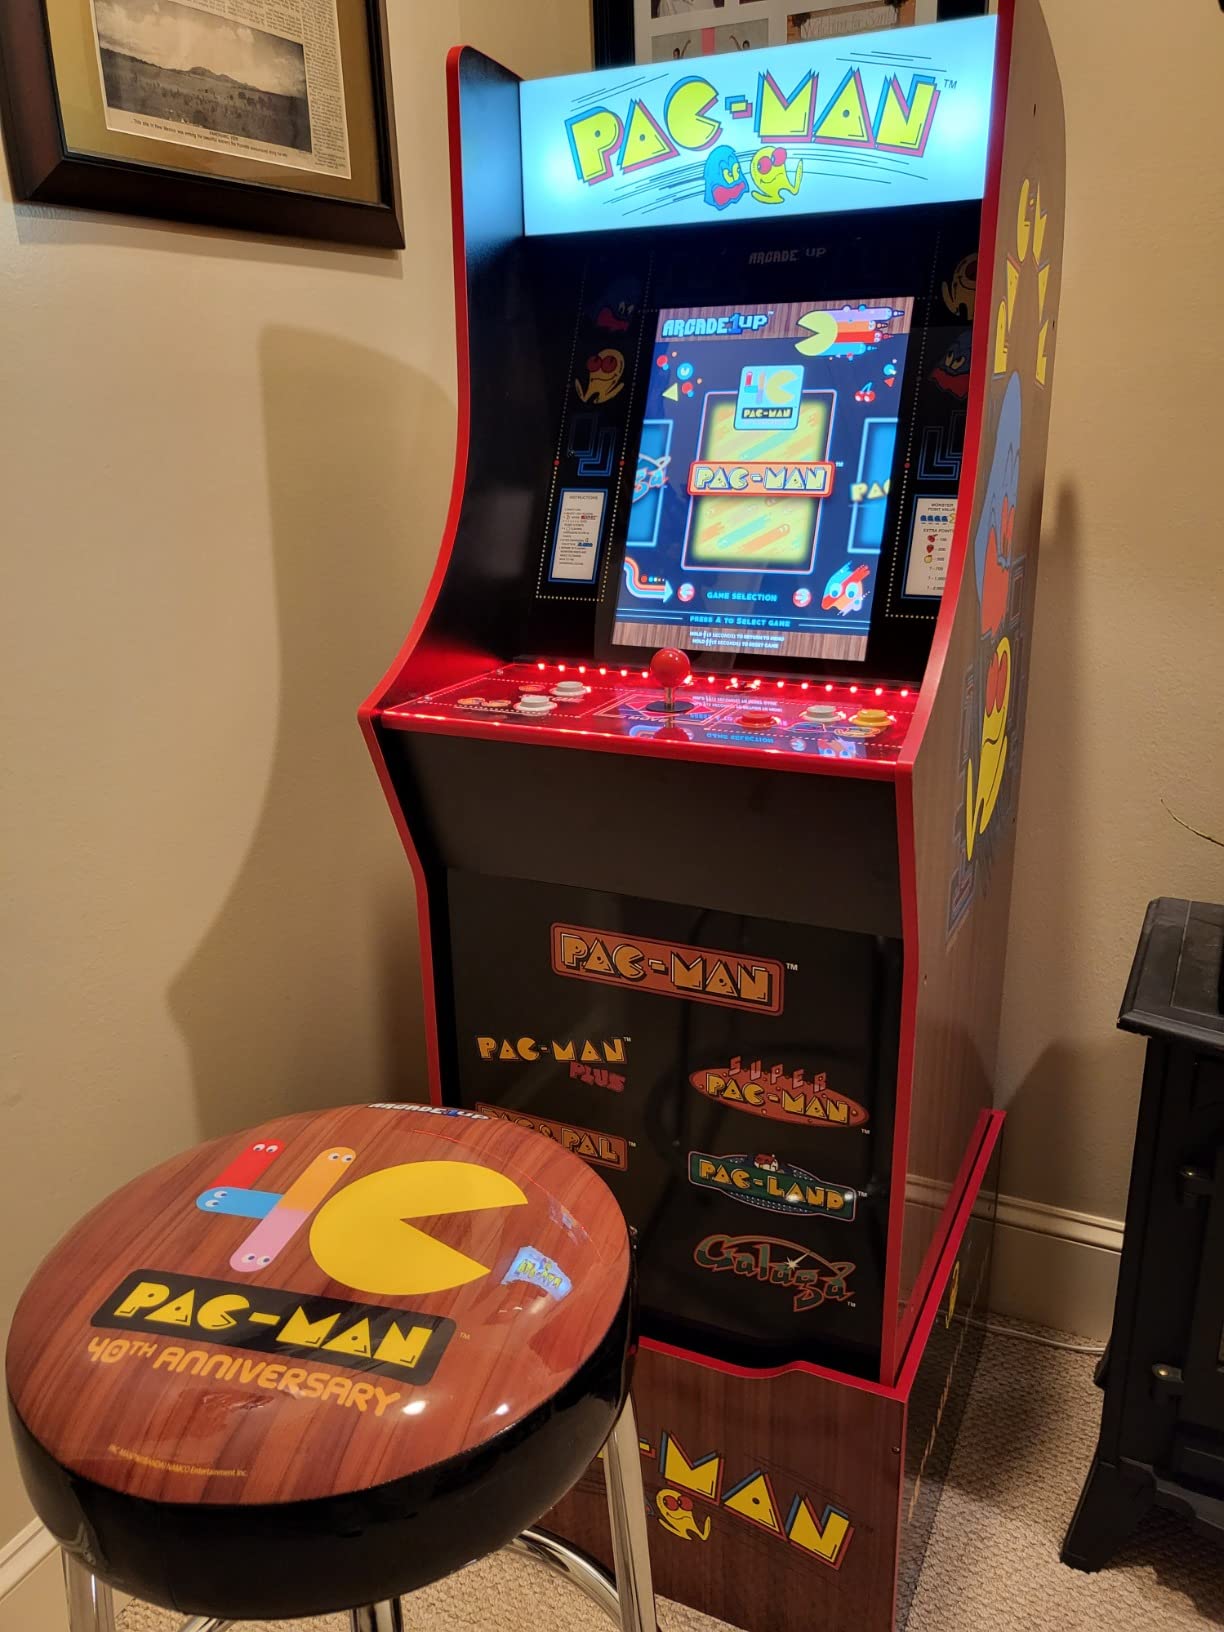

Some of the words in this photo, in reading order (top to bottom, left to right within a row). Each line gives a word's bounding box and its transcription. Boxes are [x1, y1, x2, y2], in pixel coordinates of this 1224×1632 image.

[565, 67, 940, 185] PAC-MAN
[743, 408, 791, 418] PAC-MAN
[694, 467, 826, 490] PAC-MAN
[707, 591, 730, 600] GAME
[732, 592, 777, 602] SELECTION
[736, 617, 766, 626] SELECT
[768, 620, 790, 628] GAME
[560, 932, 772, 1005] PAC-MAN
[476, 1036, 627, 1064] PAC-MAN
[569, 1060, 626, 1092] PLUS
[728, 1056, 828, 1093] SUPER
[706, 1072, 849, 1124] PAC-MAN
[562, 1128, 620, 1163] PAL
[699, 1159, 844, 1211] PAC-LAND
[694, 1234, 856, 1313] Galaga
[113, 1281, 433, 1369] PAC-MAN
[87, 1336, 158, 1365] 40TH
[152, 1346, 401, 1417] ANNIVERSARY
[640, 1430, 854, 1570] -MAN
